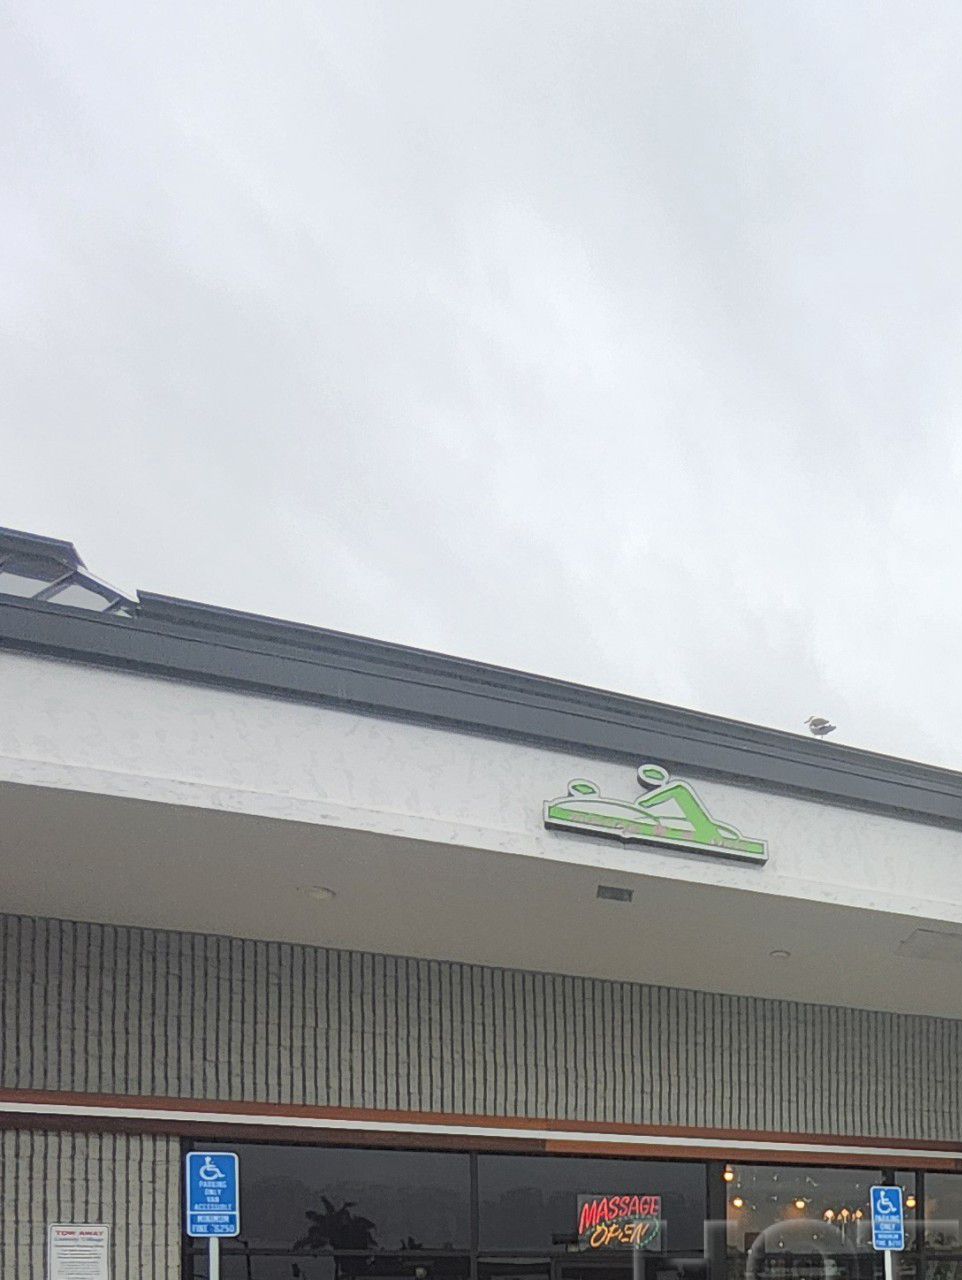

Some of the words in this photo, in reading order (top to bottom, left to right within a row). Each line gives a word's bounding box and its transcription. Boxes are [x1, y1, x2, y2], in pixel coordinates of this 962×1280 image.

[198, 1180, 228, 1188] PARKING
[204, 1188, 222, 1196] ONLY
[578, 1194, 661, 1236] MASSAGE
[589, 1222, 650, 1249] OPEN
